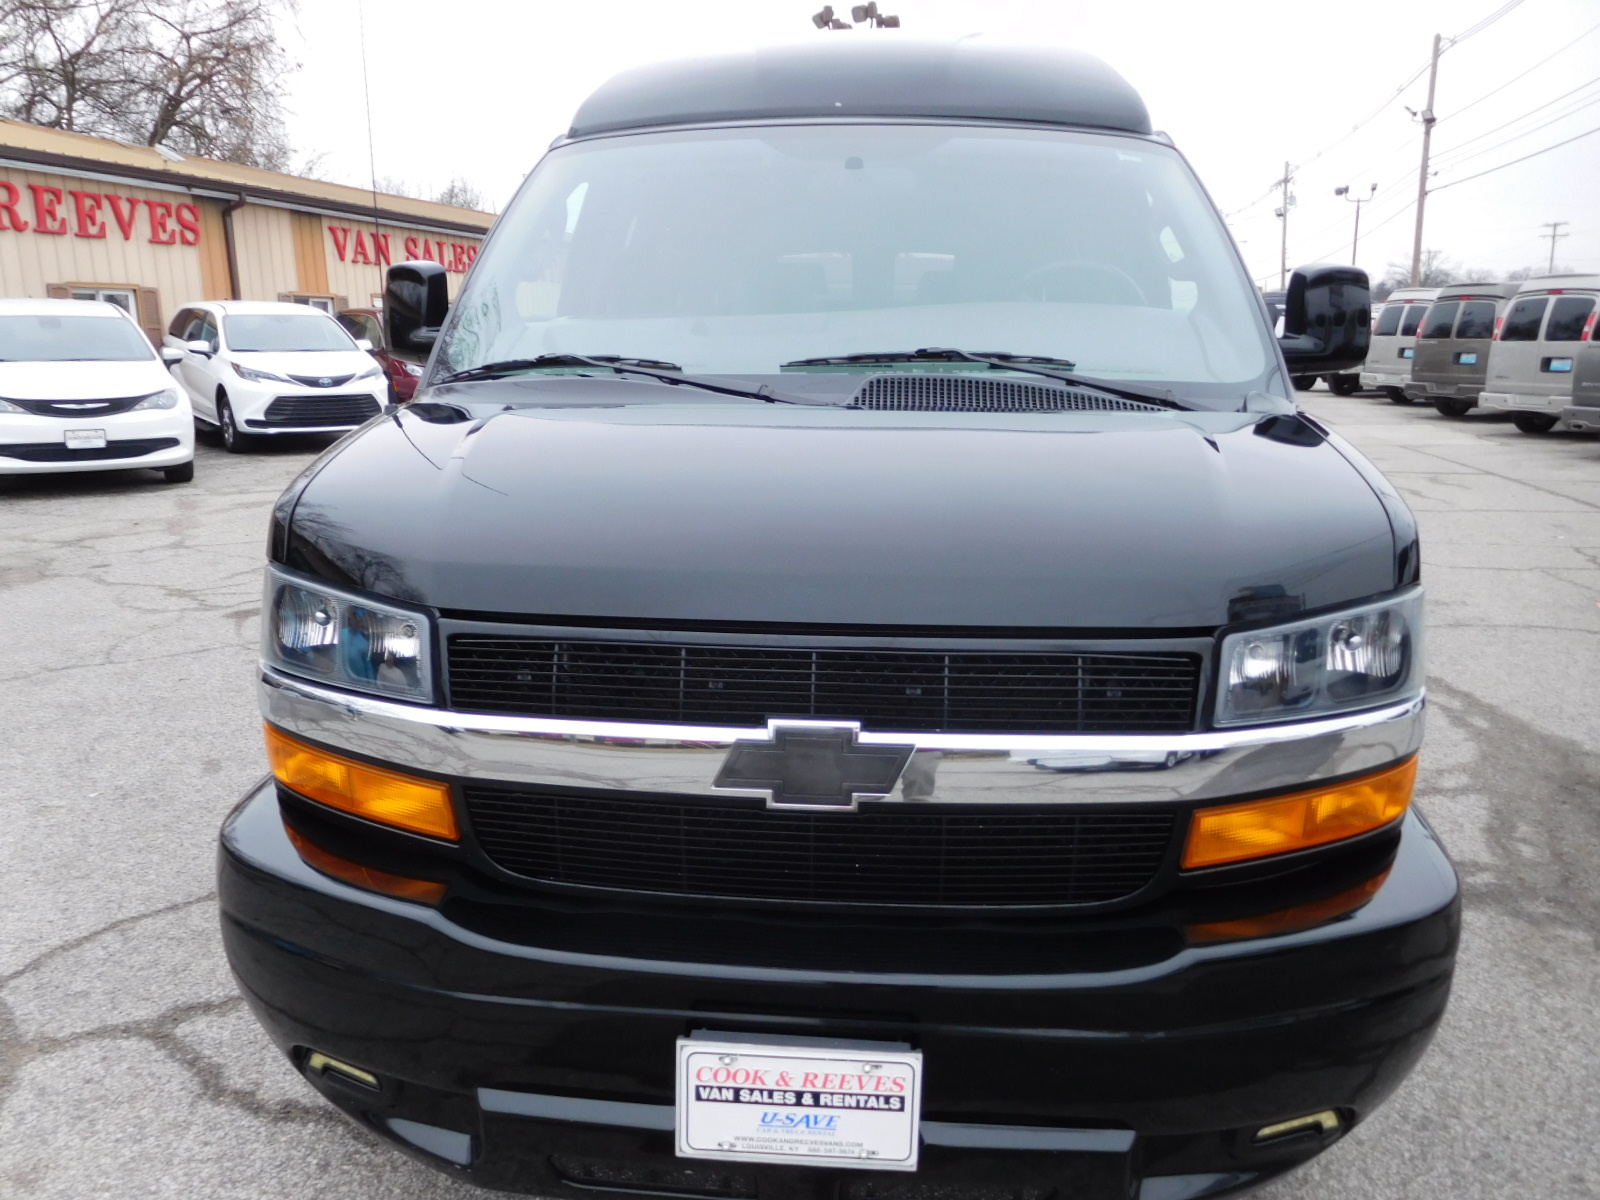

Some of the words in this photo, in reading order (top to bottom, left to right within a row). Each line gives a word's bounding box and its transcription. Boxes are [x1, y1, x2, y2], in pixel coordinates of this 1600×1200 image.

[328, 226, 392, 266] VAN
[695, 1066, 771, 1086] COOK
[775, 1071, 795, 1087] &
[802, 1071, 908, 1093] REEVES
[698, 1087, 734, 1101] VAN
[739, 1089, 796, 1105] SALES
[801, 1093, 815, 1106] &
[820, 1094, 902, 1110] RENTALS
[759, 1111, 840, 1129] U-SAVE
